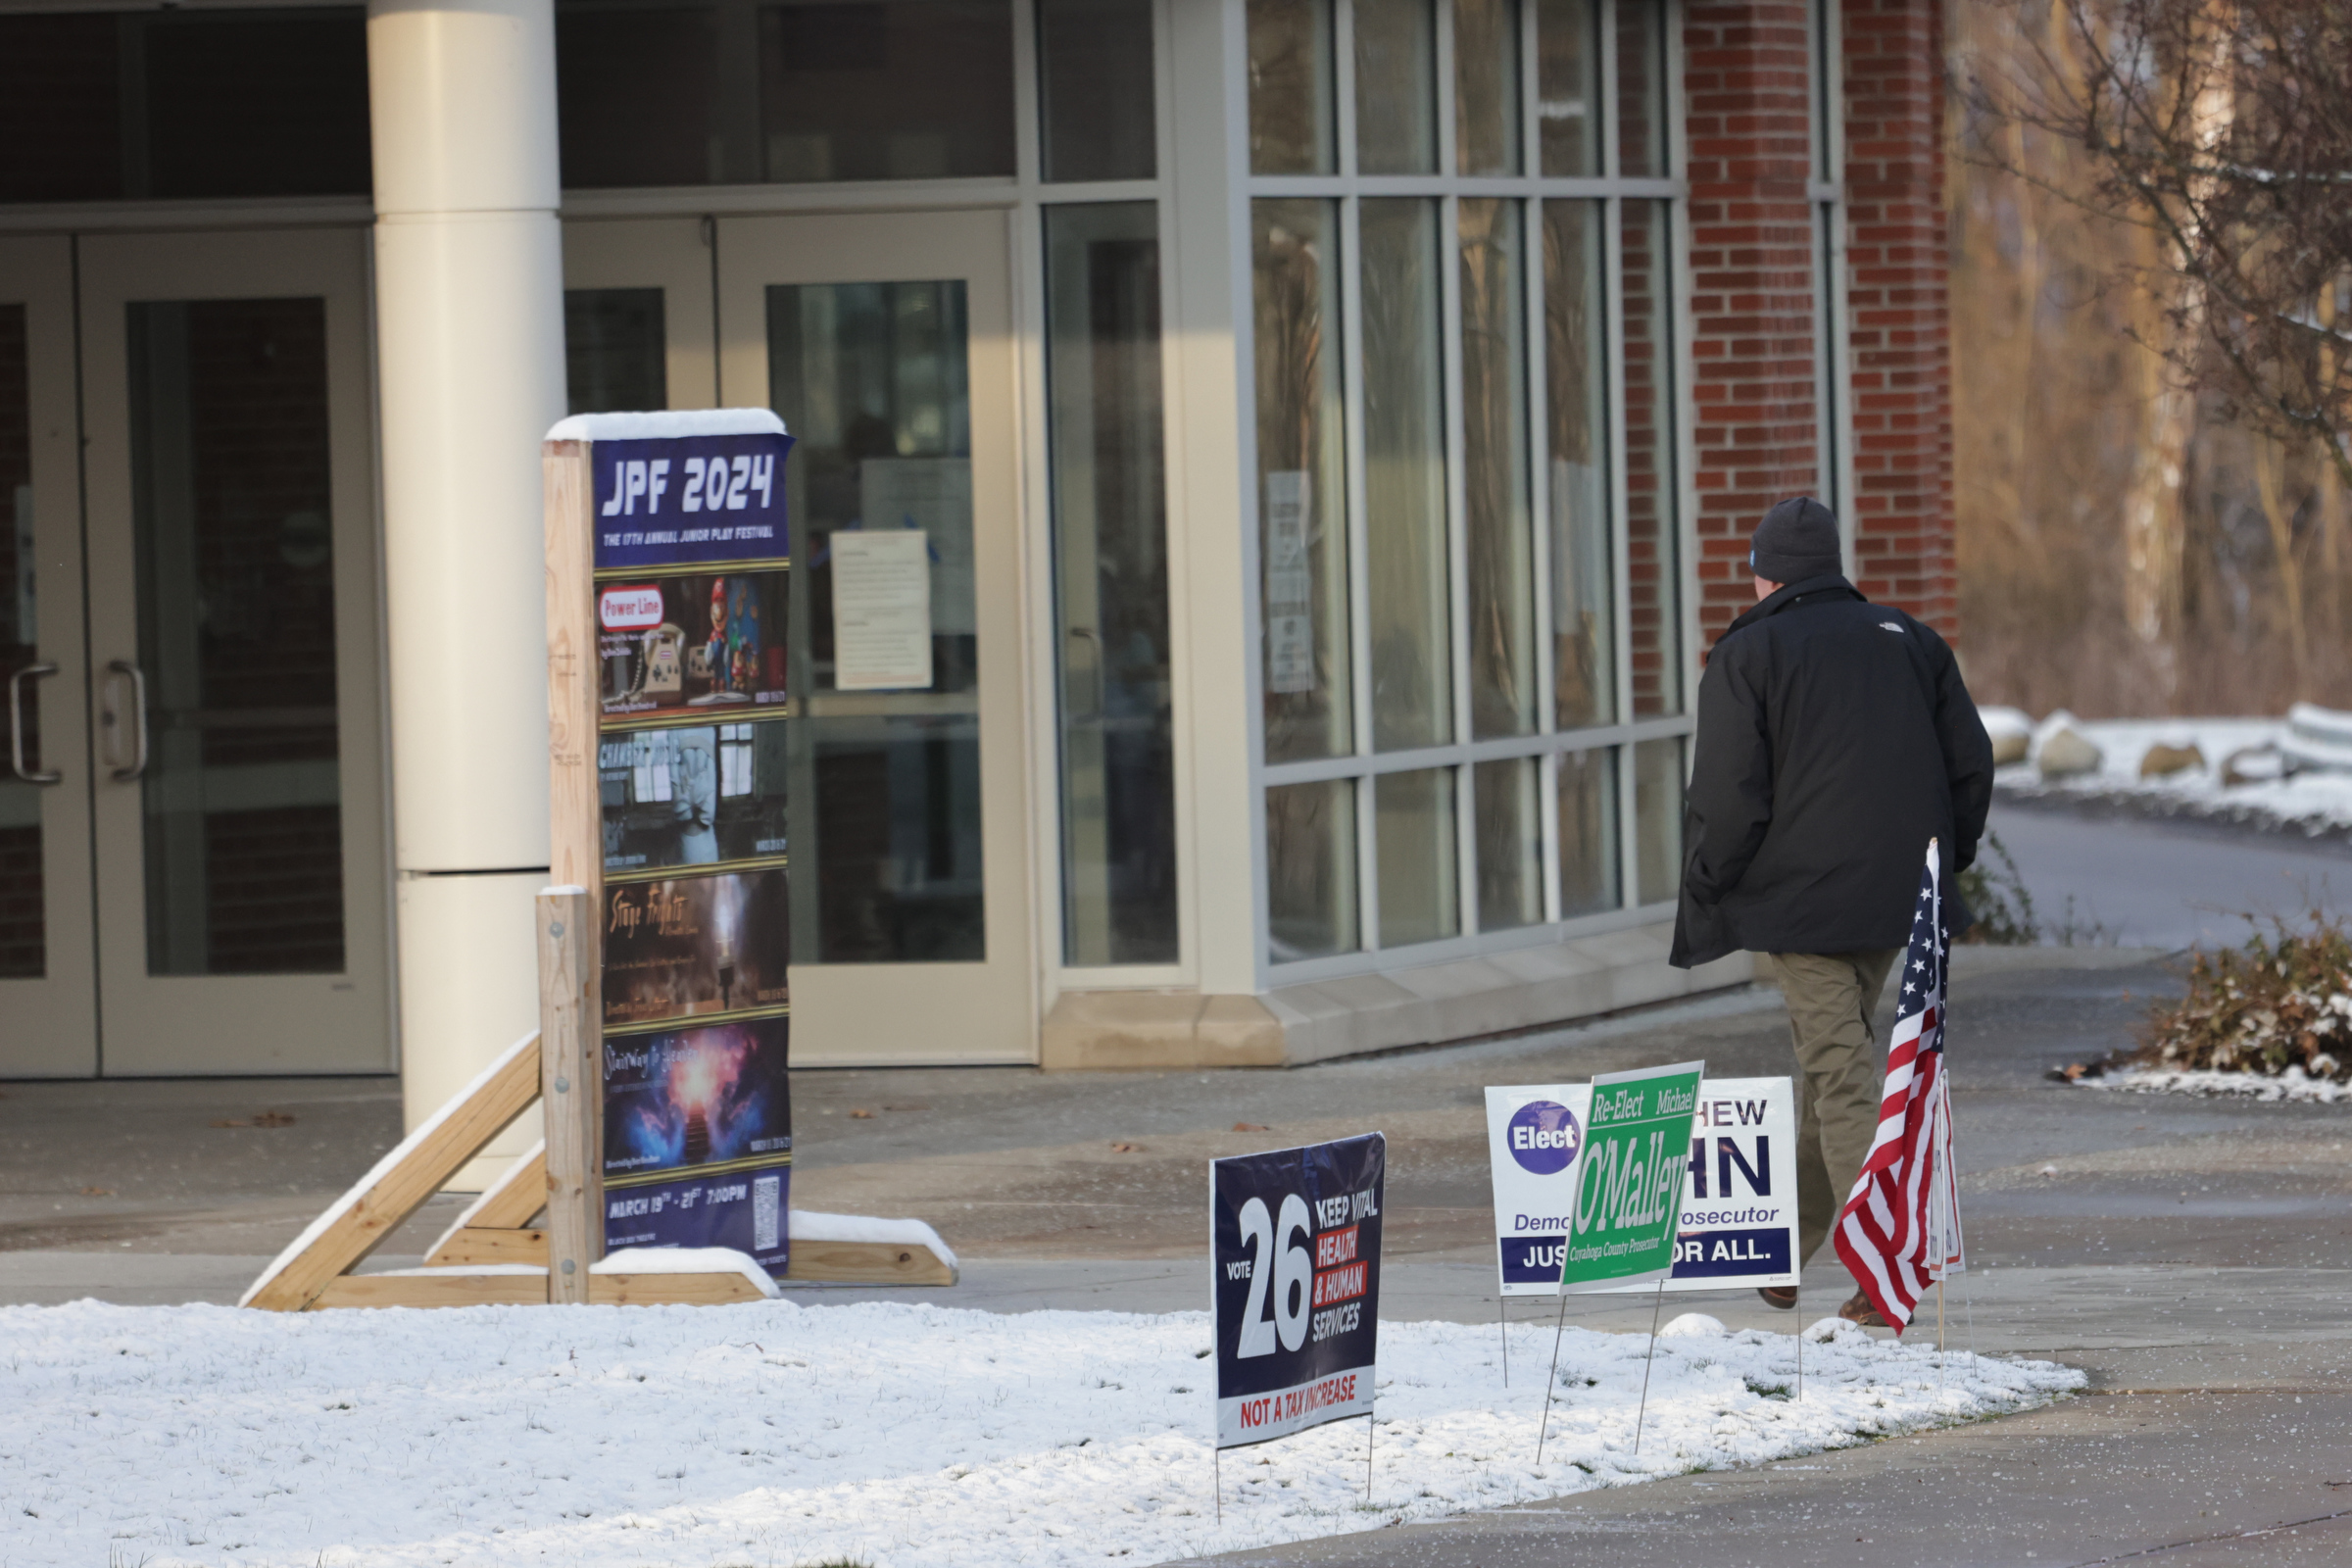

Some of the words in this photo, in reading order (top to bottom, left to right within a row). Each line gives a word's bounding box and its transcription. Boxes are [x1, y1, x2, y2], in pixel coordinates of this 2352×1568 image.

[602, 459, 670, 516] JPF
[682, 454, 774, 513] 2024
[604, 533, 620, 546] THE
[622, 532, 643, 546] 17TH
[644, 530, 678, 545] ANNUAL
[679, 529, 710, 543] JUNIOR
[710, 527, 733, 540] PLAY
[734, 525, 773, 539] FESTIVAL
[605, 599, 636, 617] Power
[638, 597, 660, 614] Line
[1592, 1090, 1644, 1123] Re-Elect
[1655, 1084, 1694, 1115] Michael
[1513, 1125, 1576, 1150] Elect
[609, 1198, 648, 1219] MARCH
[706, 1184, 747, 1205] 7:00PM
[1575, 1131, 1687, 1241] O'Malley
[1315, 1196, 1348, 1229] KEEP
[1351, 1188, 1378, 1222] VITAL
[1318, 1230, 1356, 1268] HEALTH
[1569, 1244, 1602, 1263] Cuyahoga
[1603, 1241, 1629, 1257] County
[1629, 1237, 1660, 1253] Prosecutor
[1711, 1239, 1771, 1262] ALL.
[1226, 1260, 1251, 1281] VOTE
[1237, 1193, 1312, 1359] 26
[1314, 1275, 1323, 1304] &
[1325, 1264, 1363, 1302] HUMAN
[1312, 1301, 1361, 1343] SERVICES
[1241, 1397, 1270, 1429] NOT
[1273, 1396, 1282, 1423] A
[1286, 1390, 1305, 1420] TAX
[1304, 1374, 1356, 1413] INCREASE
